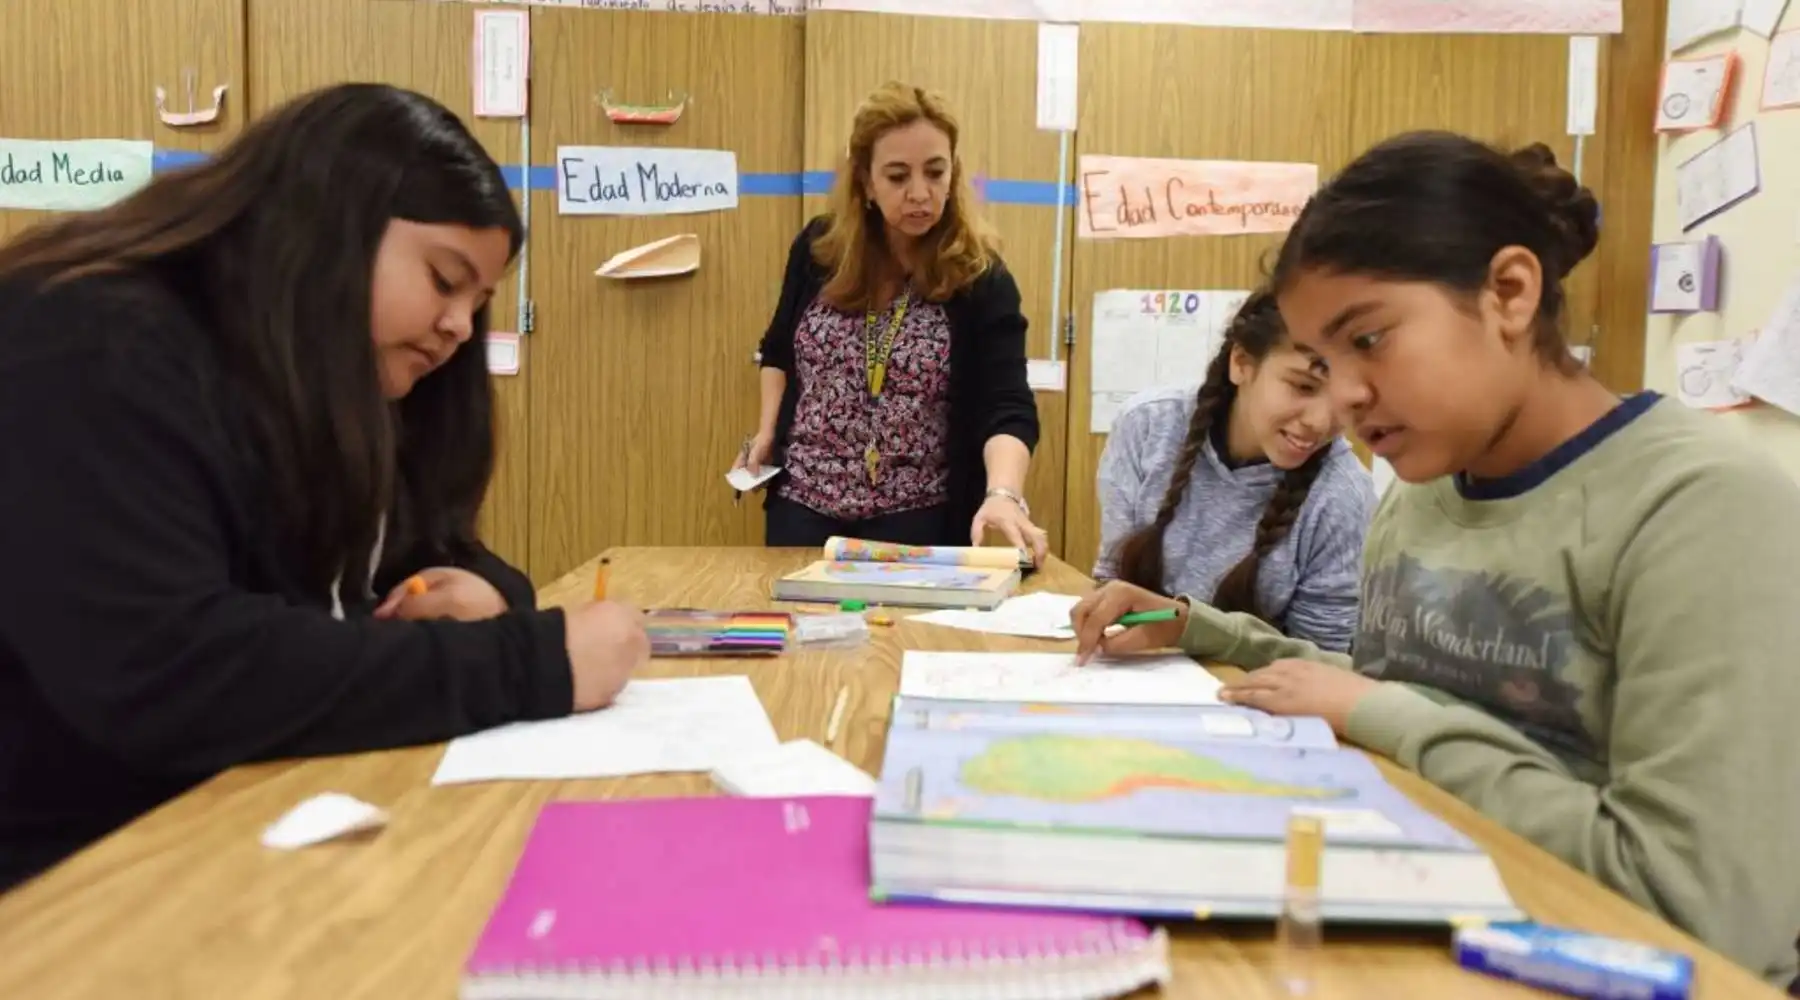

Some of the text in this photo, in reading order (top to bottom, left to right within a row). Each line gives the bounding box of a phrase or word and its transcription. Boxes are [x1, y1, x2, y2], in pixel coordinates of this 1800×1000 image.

[52, 151, 124, 185] Media
[562, 158, 728, 202] Edad Moderna
[1084, 171, 1156, 232] Edad
[1140, 292, 1200, 314] 1920
[1415, 604, 1551, 670] Wonderland
